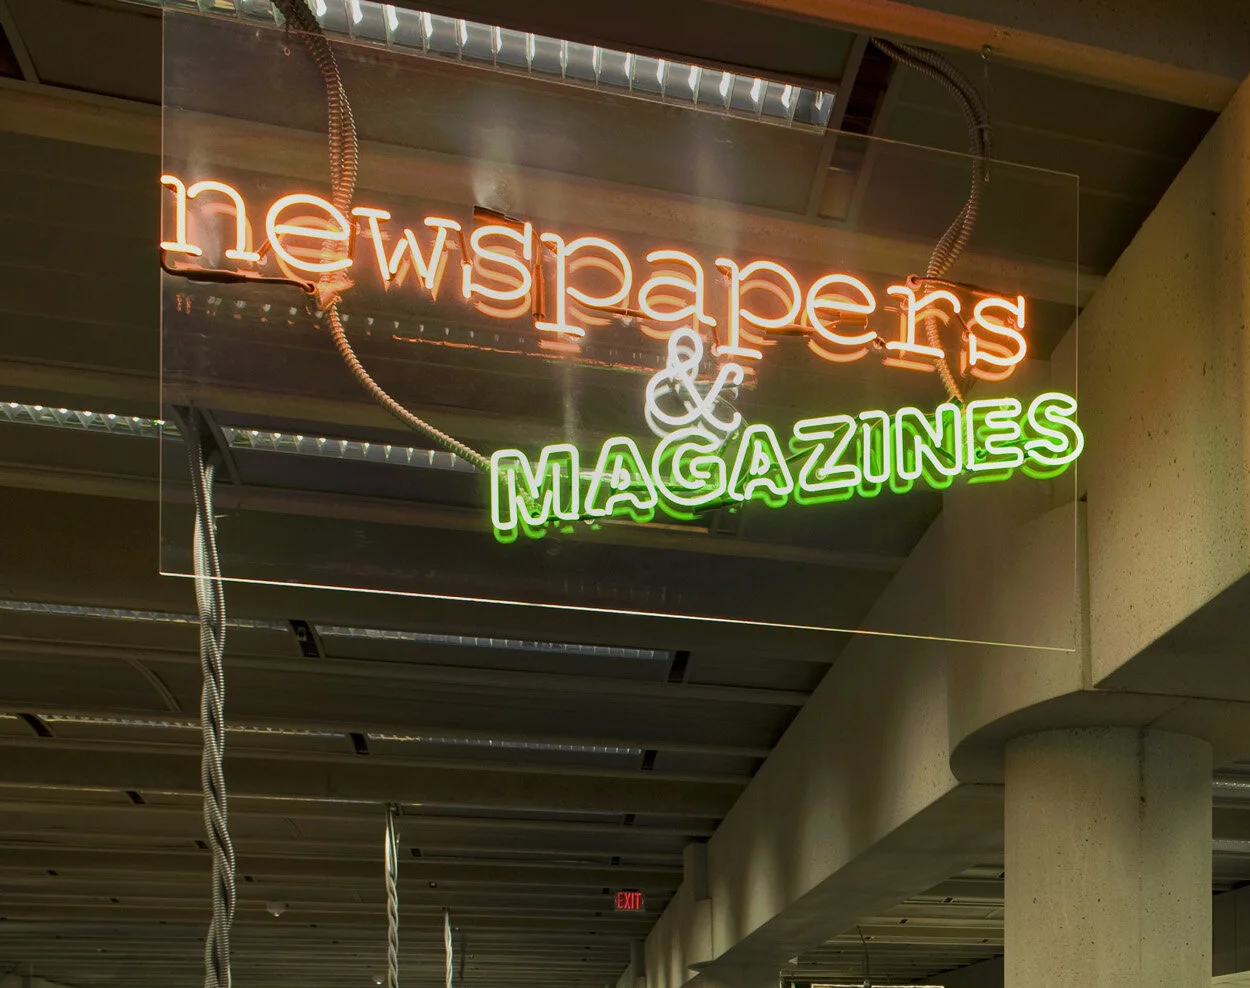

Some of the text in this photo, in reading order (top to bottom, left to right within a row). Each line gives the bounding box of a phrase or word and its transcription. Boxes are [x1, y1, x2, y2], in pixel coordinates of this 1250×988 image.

[160, 173, 1029, 368] newspapers
[645, 330, 743, 432] &
[490, 392, 1084, 532] MAGAZINES
[617, 892, 642, 910] EXIT
